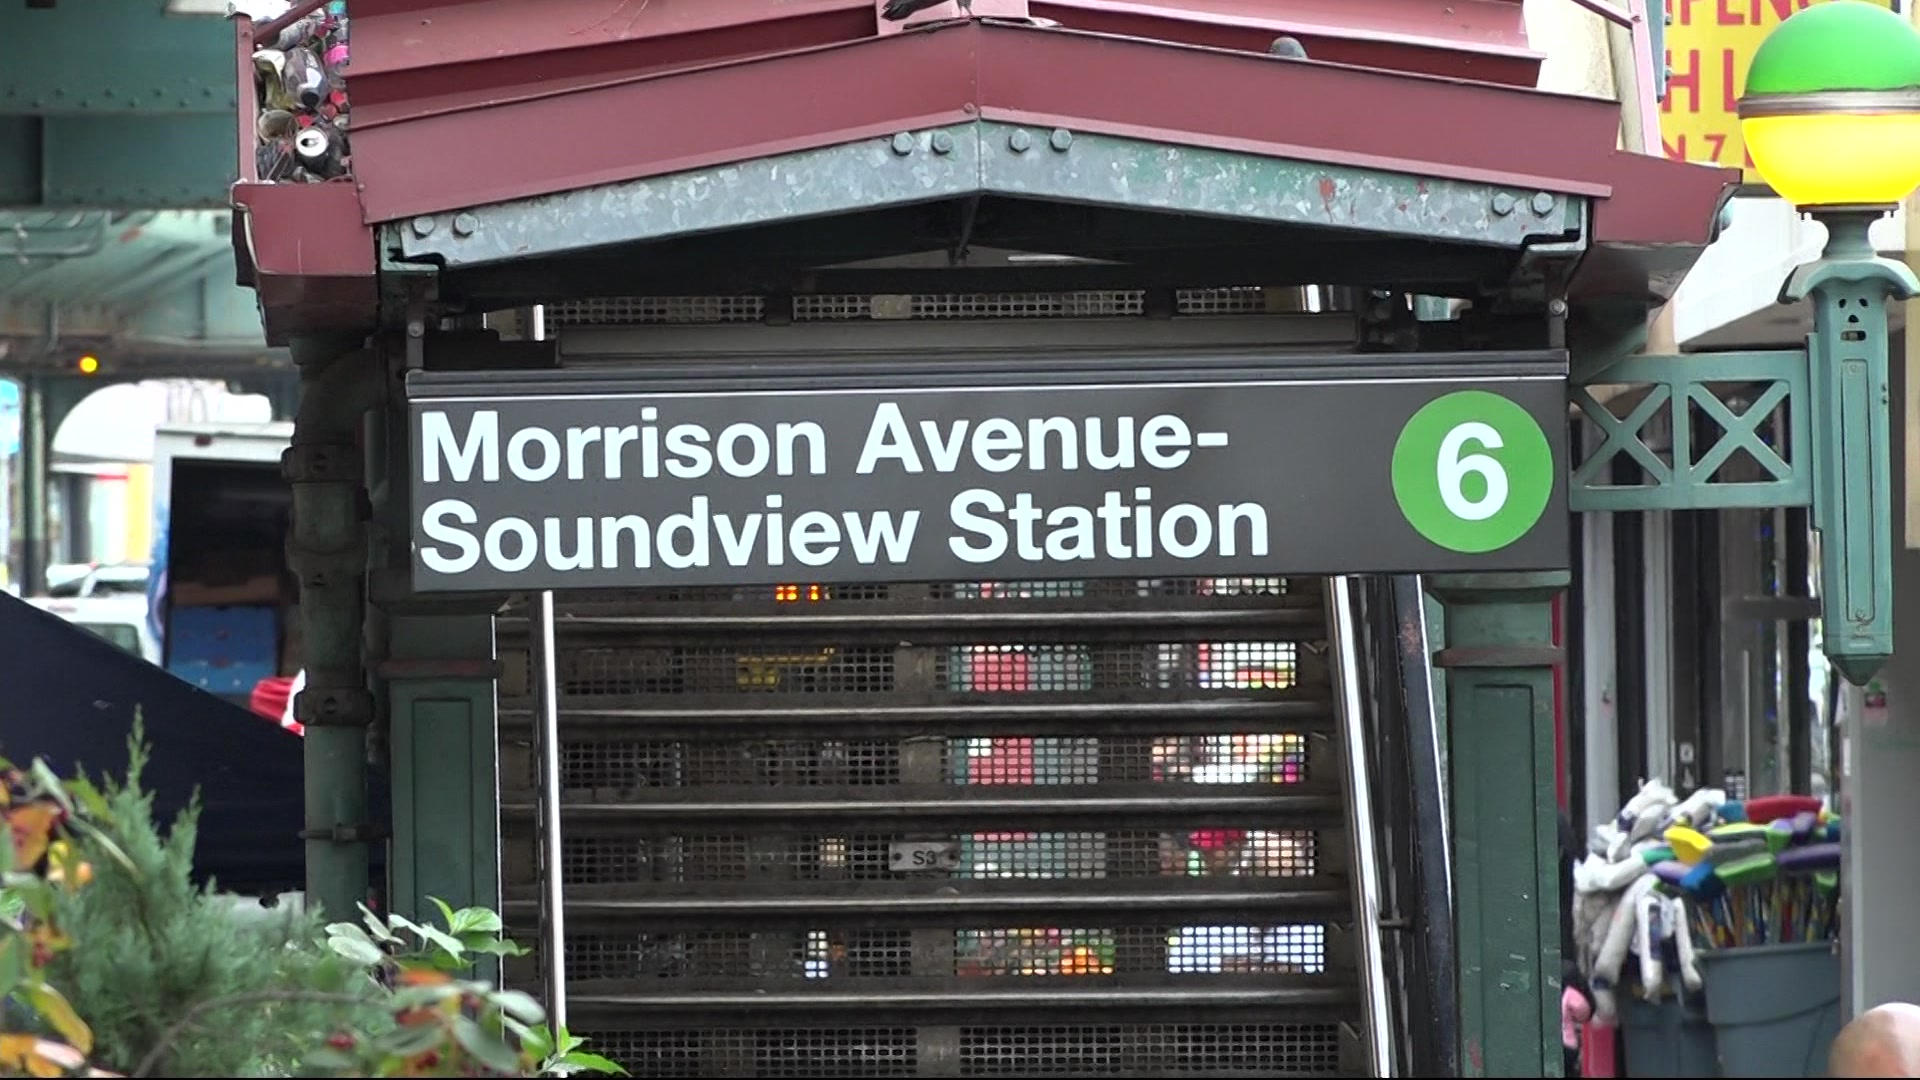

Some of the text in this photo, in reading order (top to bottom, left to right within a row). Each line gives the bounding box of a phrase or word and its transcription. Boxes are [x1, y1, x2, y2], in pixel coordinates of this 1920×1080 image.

[421, 402, 1228, 483] Morrison Avenue-
[1436, 421, 1509, 521] 6
[420, 487, 1268, 574] Soundview Station
[912, 850, 937, 865] S3
